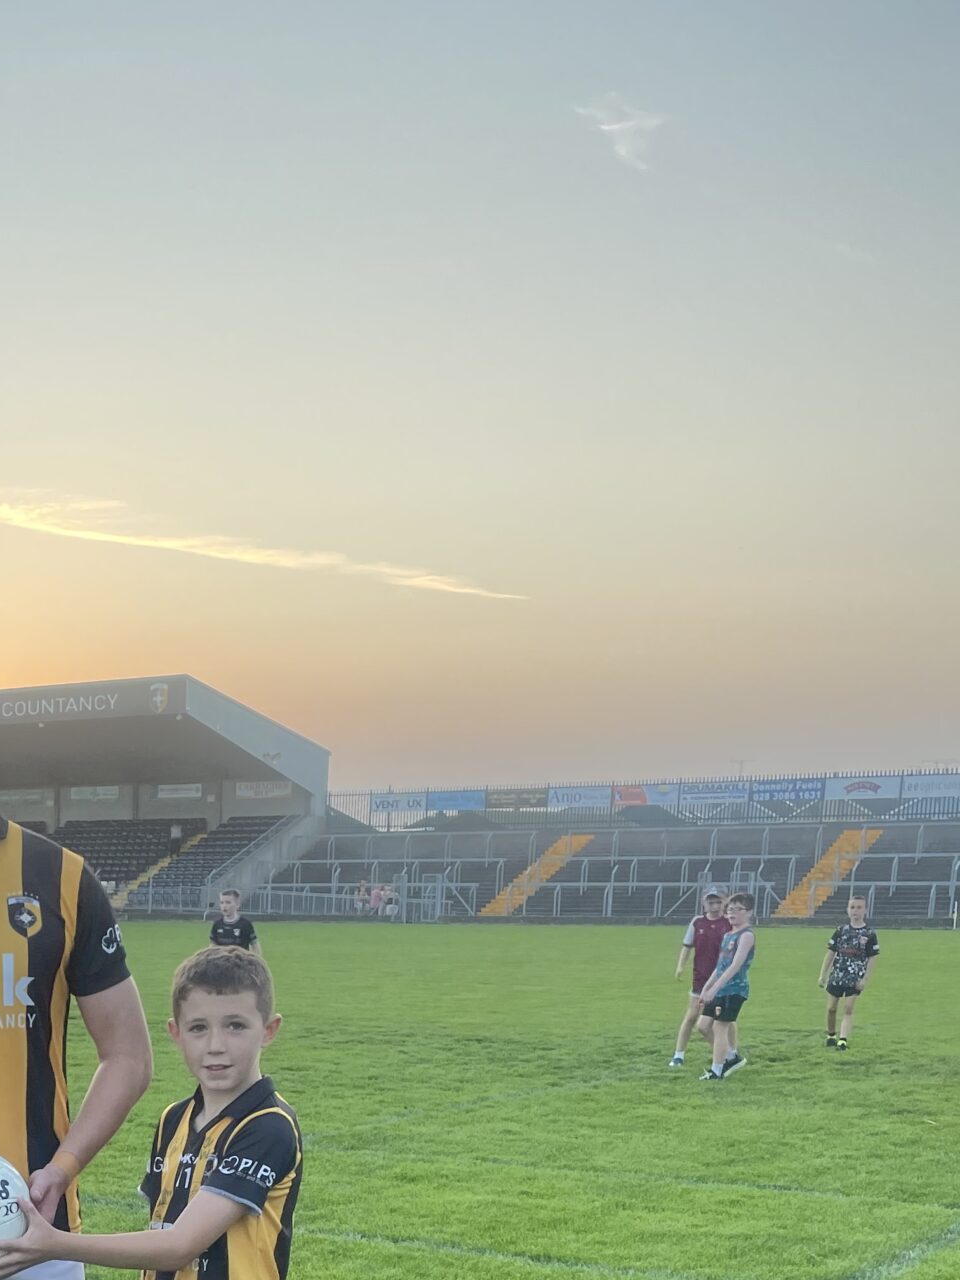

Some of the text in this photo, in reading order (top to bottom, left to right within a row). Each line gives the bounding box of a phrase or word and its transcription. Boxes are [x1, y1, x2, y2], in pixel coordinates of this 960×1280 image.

[682, 783, 747, 793] DRUMAKILL
[752, 780, 822, 792] Donnelly Fuels
